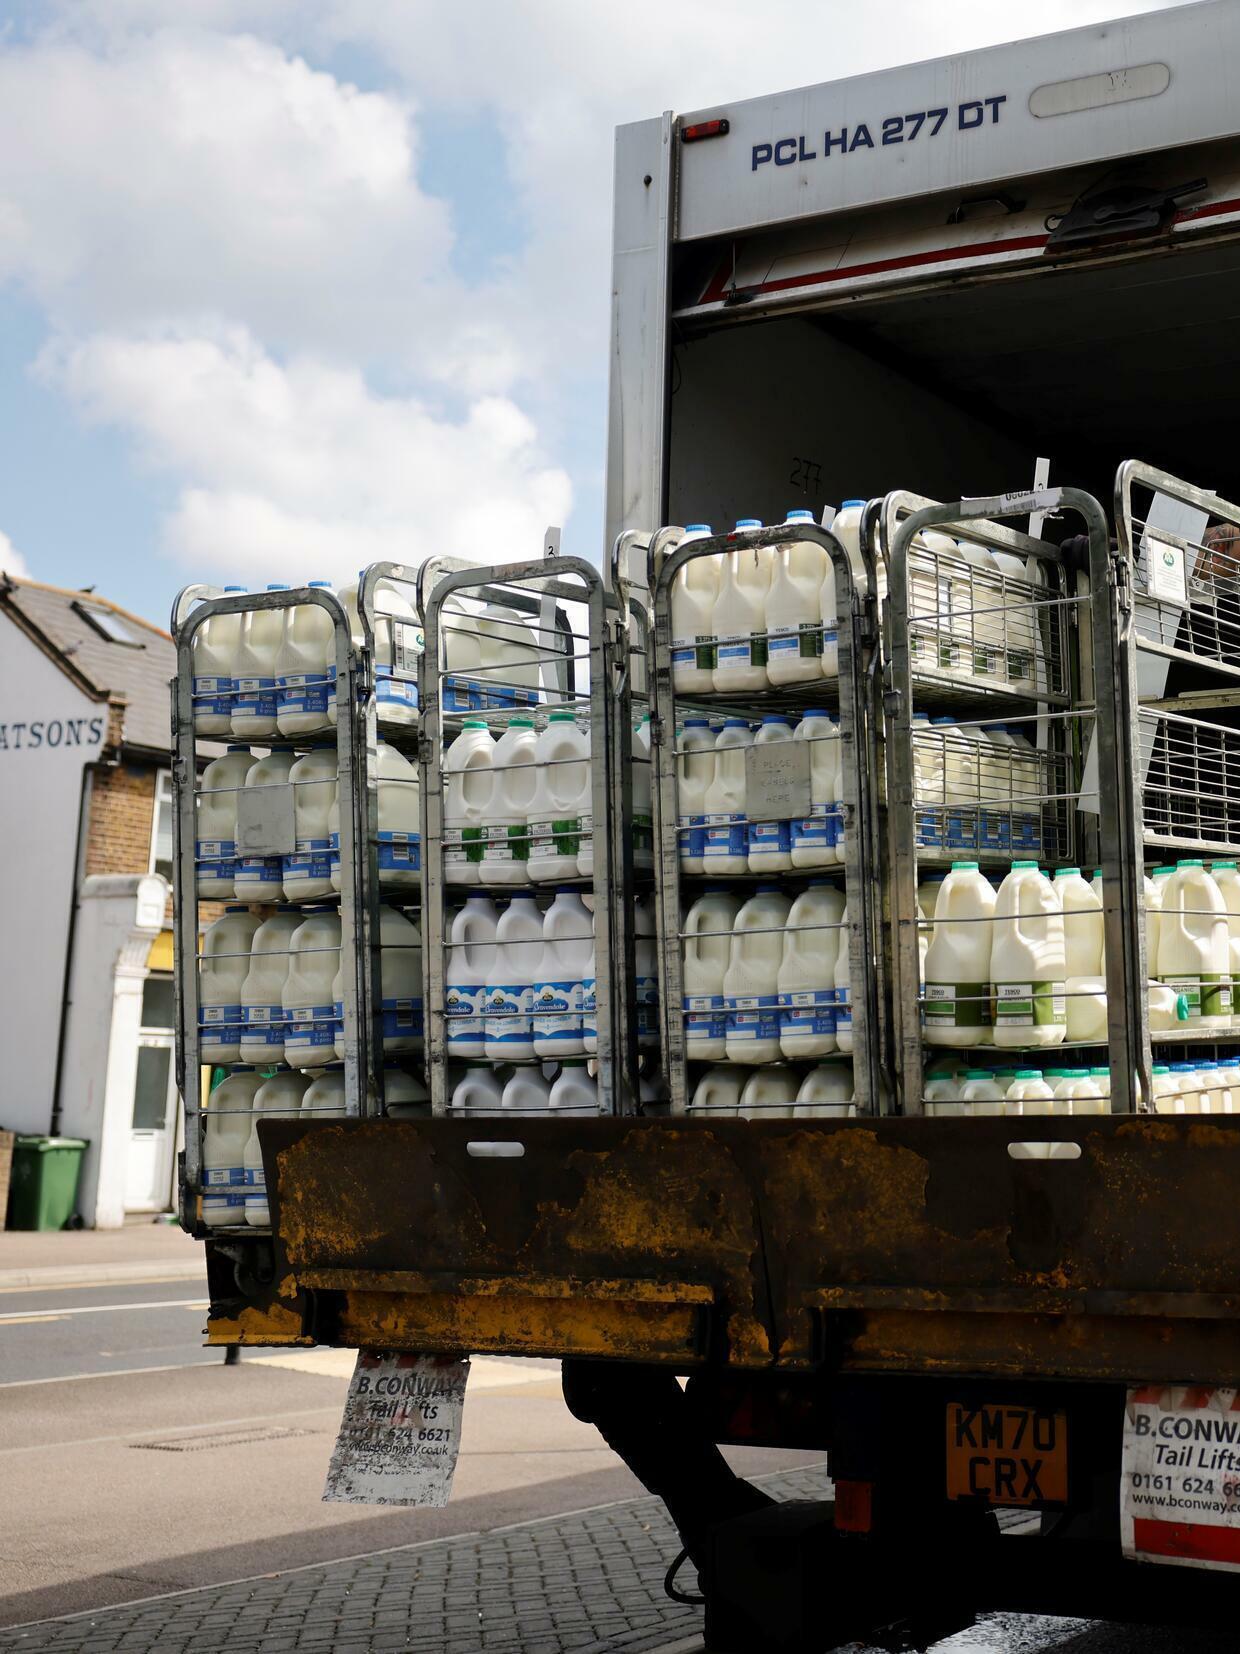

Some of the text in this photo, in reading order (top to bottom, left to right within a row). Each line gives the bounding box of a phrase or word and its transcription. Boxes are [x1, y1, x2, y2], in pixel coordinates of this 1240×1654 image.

[752, 95, 1006, 171] PCL HA 277 DT
[402, 1400, 438, 1420] Lts
[418, 1427, 451, 1442] 6621
[955, 1407, 1056, 1452] KM70
[1155, 1444, 1193, 1467] Tail
[968, 1456, 1044, 1499] CRX
[1132, 1473, 1172, 1491] 0161
[1182, 1477, 1214, 1495] 624
